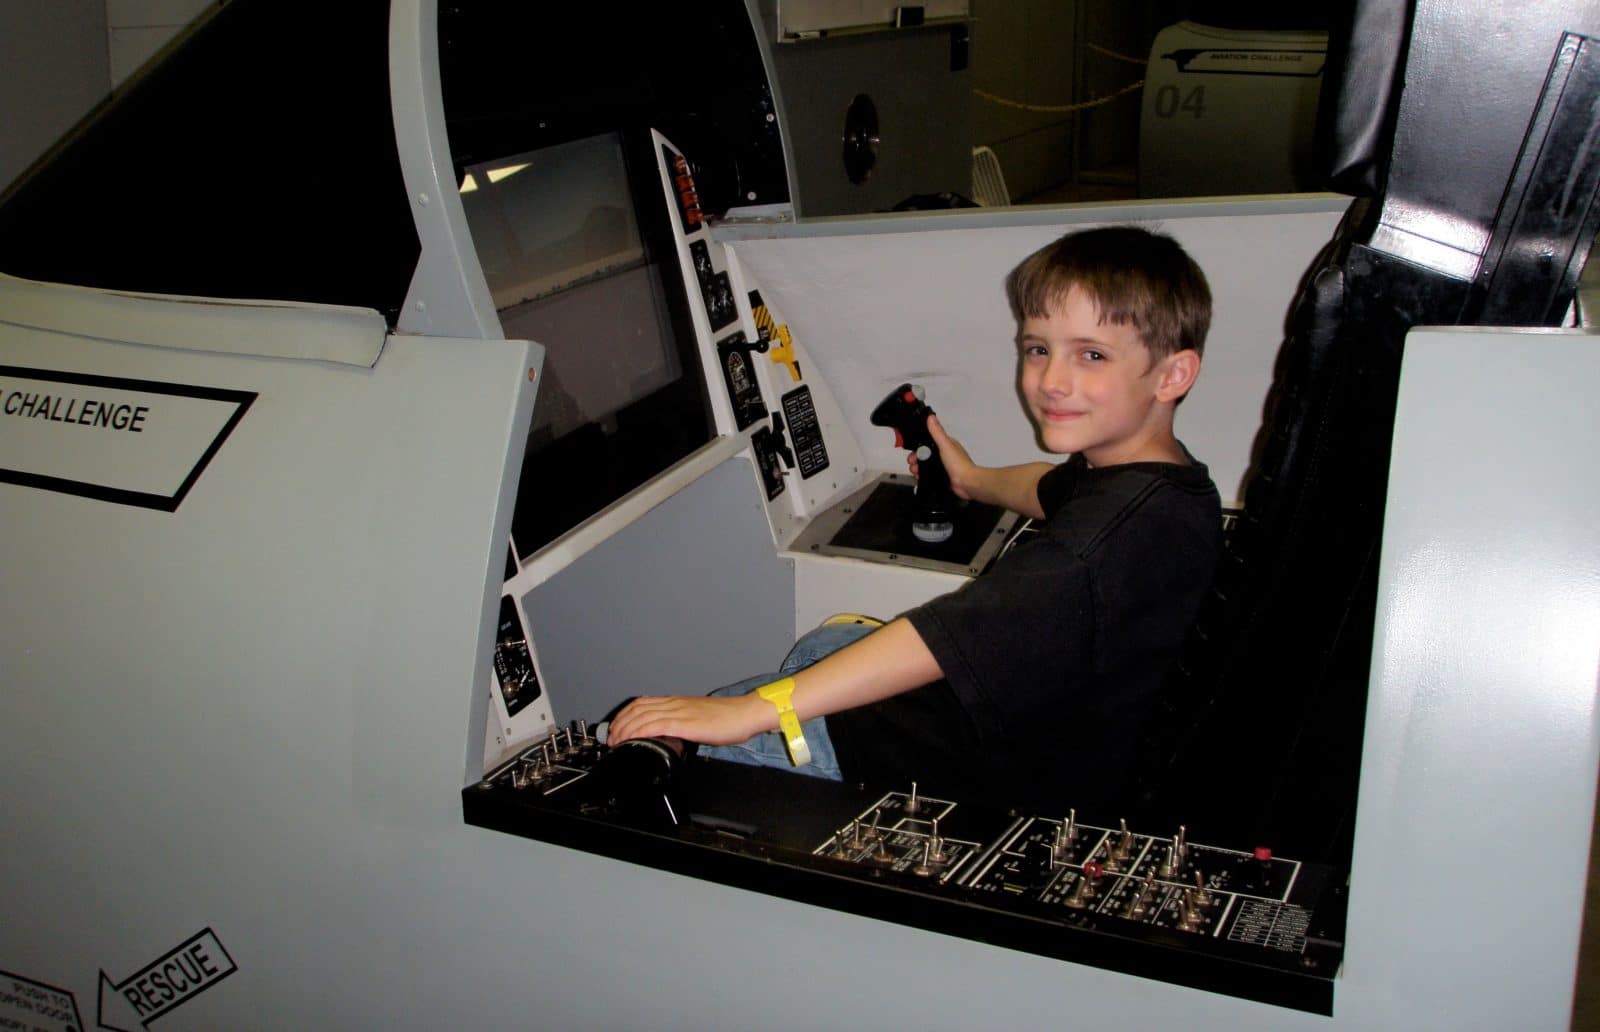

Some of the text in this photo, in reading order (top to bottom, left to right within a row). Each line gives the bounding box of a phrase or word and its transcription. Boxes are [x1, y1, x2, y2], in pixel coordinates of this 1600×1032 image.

[1250, 54, 1303, 62] CHALLENGE
[1155, 84, 1207, 119] 04
[4, 391, 149, 432] CHALLENGE
[123, 944, 218, 1016] RESCUE
